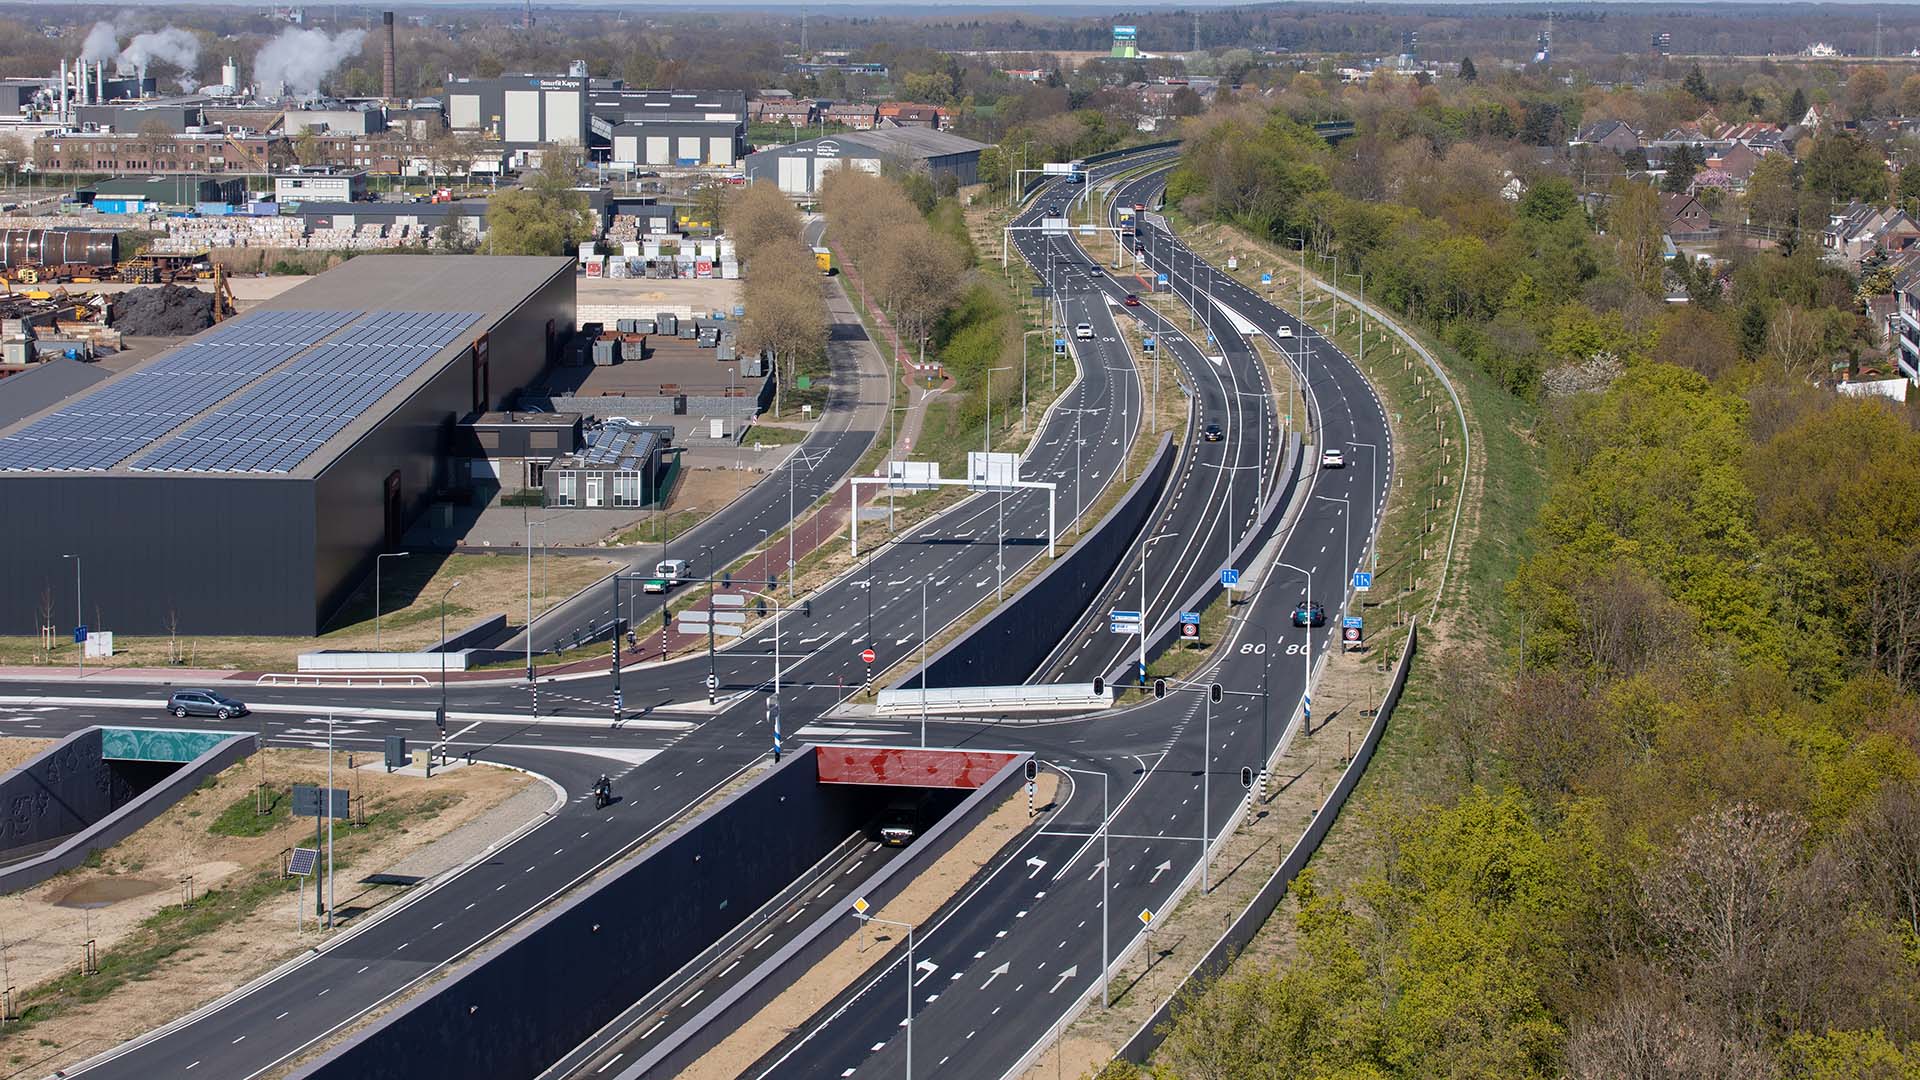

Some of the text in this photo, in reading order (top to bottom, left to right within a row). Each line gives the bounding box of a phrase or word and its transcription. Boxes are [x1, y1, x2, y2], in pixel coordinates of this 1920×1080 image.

[562, 80, 580, 88] Kappa
[1239, 643, 1266, 654] 80
[1285, 644, 1311, 655] 80
